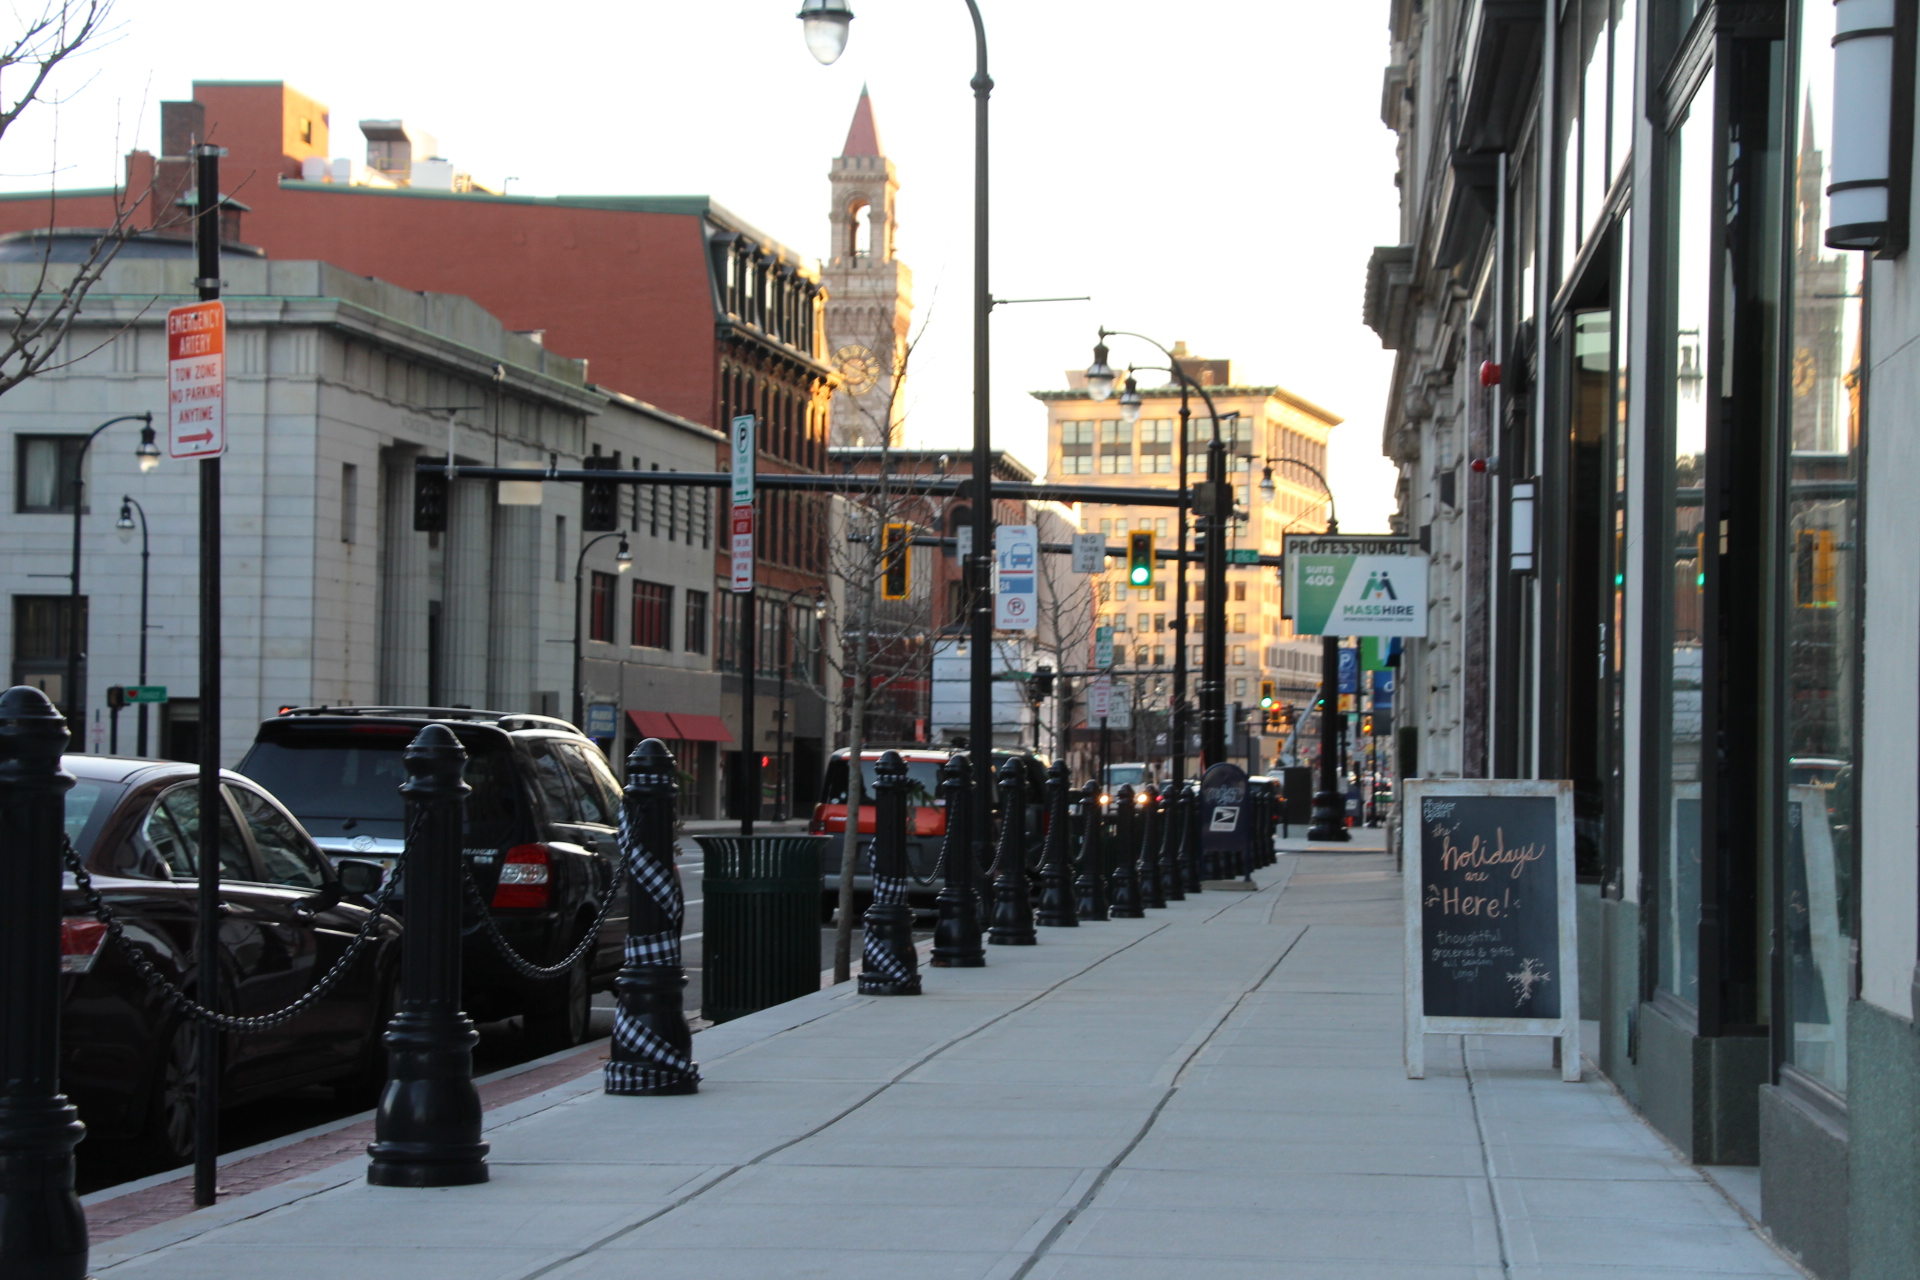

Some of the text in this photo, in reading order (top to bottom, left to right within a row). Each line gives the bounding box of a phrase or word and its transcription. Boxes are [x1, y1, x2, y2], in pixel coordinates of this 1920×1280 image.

[170, 310, 220, 334] EMERGENCY
[179, 334, 211, 356] ARTERY
[175, 363, 217, 382] TOW ZONE
[171, 384, 221, 403] NO PARKING
[178, 406, 214, 424] ANYTIME
[1081, 535, 1096, 544] NO
[1289, 540, 1408, 555] PROFESSIONAL
[1305, 565, 1335, 574] SUITE
[1305, 575, 1335, 586] 400
[1343, 604, 1415, 615] MASSHIRE
[1464, 872, 1489, 881] are
[1443, 887, 1511, 918] Here!
